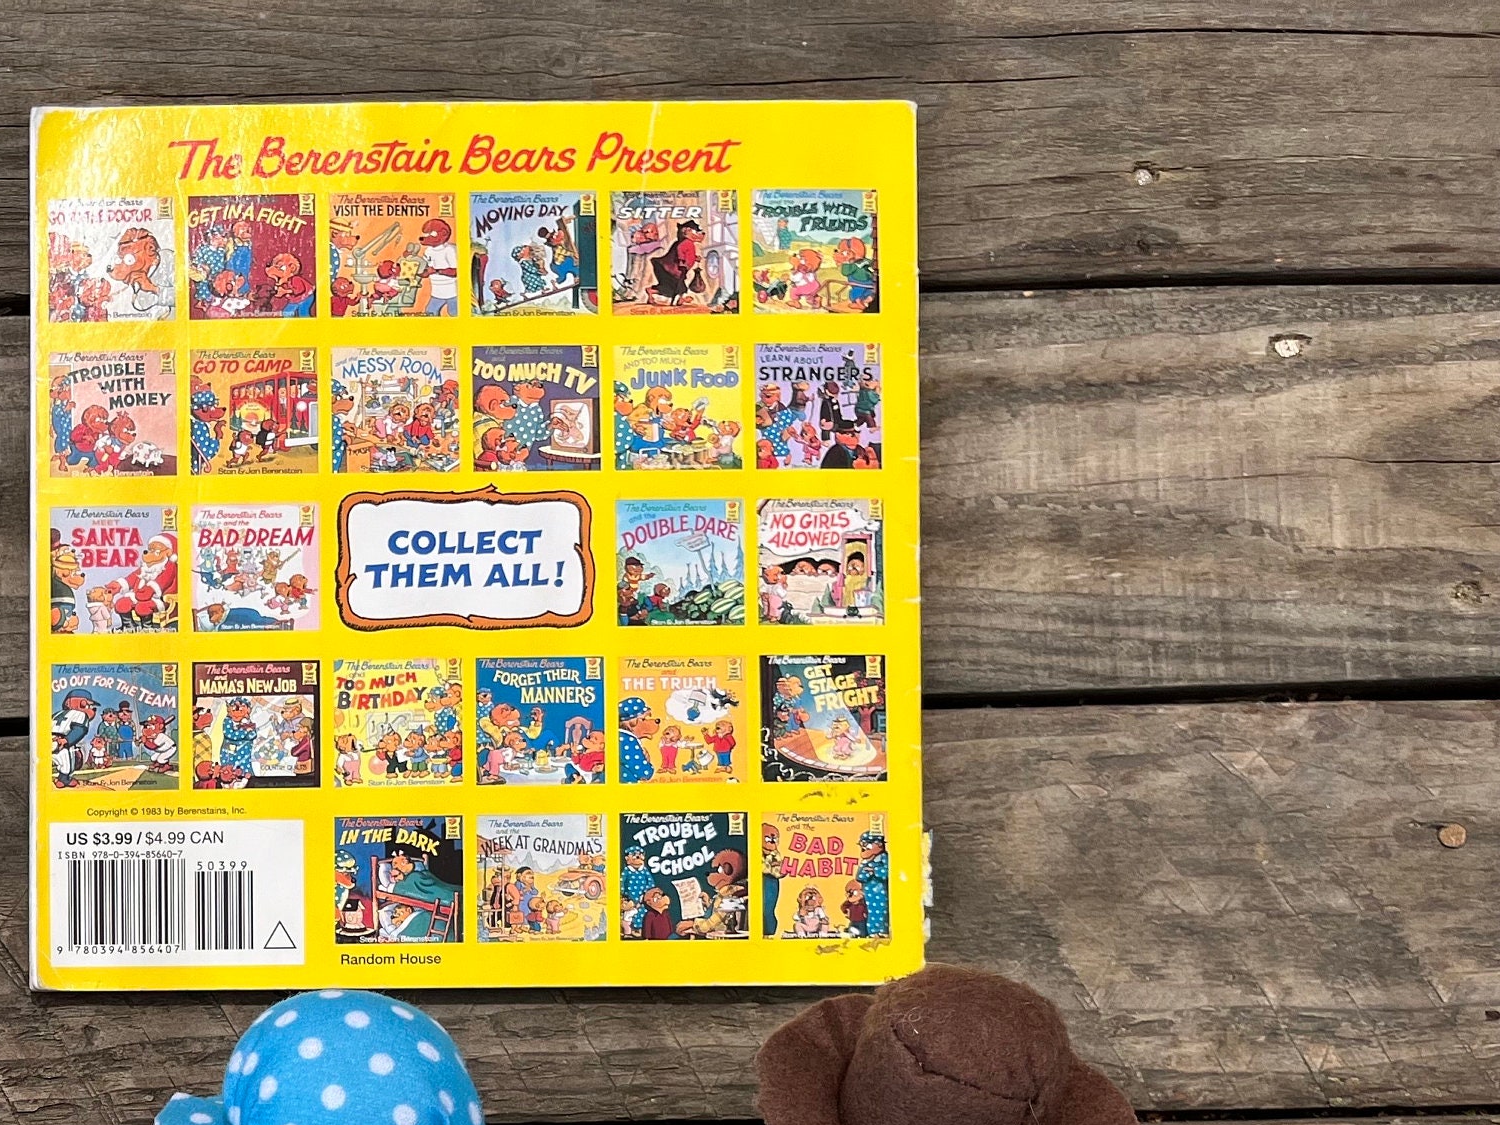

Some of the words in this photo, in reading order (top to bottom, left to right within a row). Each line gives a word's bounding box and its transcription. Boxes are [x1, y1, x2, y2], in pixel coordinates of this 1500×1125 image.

[167, 137, 242, 181] The
[250, 136, 452, 179] Berenstain
[458, 134, 576, 175] Bears
[586, 131, 742, 174] Present
[617, 206, 702, 220] SITTER
[341, 356, 395, 379] MESSY
[399, 357, 442, 383] ROOM
[759, 354, 790, 365] LEARN
[792, 355, 823, 365] ABOUT
[630, 367, 686, 389] JUNK
[690, 368, 739, 388] FOOD
[758, 366, 873, 382] STRANGERS
[64, 509, 80, 519] The
[82, 509, 122, 519] Berenstain
[124, 510, 149, 520] Bears
[386, 529, 542, 555] COLLECT
[363, 562, 471, 589] THEM
[482, 560, 565, 588] ALL!
[335, 676, 364, 692] TOO
[368, 671, 417, 690] MUCH
[492, 668, 541, 688] FORGET
[543, 668, 581, 685] THEIR
[802, 664, 833, 679] GET
[51, 678, 67, 693] GO
[69, 676, 89, 687] OUT
[93, 676, 113, 688] FOR
[115, 680, 135, 697] THE
[138, 689, 176, 709] TEAM
[621, 676, 653, 690] THE
[658, 676, 716, 690] TRUTH
[806, 674, 857, 696] STAGE
[336, 687, 427, 711] BIRTHDAY
[519, 687, 595, 708] MANNERS
[811, 686, 879, 712] FRIGHT
[87, 807, 128, 818] Copyright
[141, 807, 162, 816] 1983
[164, 807, 175, 817] by
[177, 806, 229, 817] Berenstains,
[231, 806, 247, 815] Inc.
[66, 832, 88, 846] US
[92, 831, 132, 846] $3.99
[136, 831, 142, 845] /
[145, 831, 185, 846] $4.99
[190, 830, 224, 844] CAN
[631, 821, 717, 847] TROUBLE
[787, 833, 843, 855] BAD
[57, 850, 85, 860] ISBN
[92, 850, 183, 859] 978-0-394-85640-7
[480, 835, 513, 856] WEEK
[513, 834, 530, 848] AT
[532, 836, 603, 856] GRANDMA'S
[659, 839, 686, 856] AT
[197, 861, 248, 870] 50399
[647, 845, 714, 876] SCHOOL
[779, 856, 857, 878] HABIT
[57, 946, 63, 955] 9
[75, 945, 123, 954] 780394
[131, 945, 180, 954] 856407
[340, 953, 395, 965] Random
[400, 953, 441, 965] House
